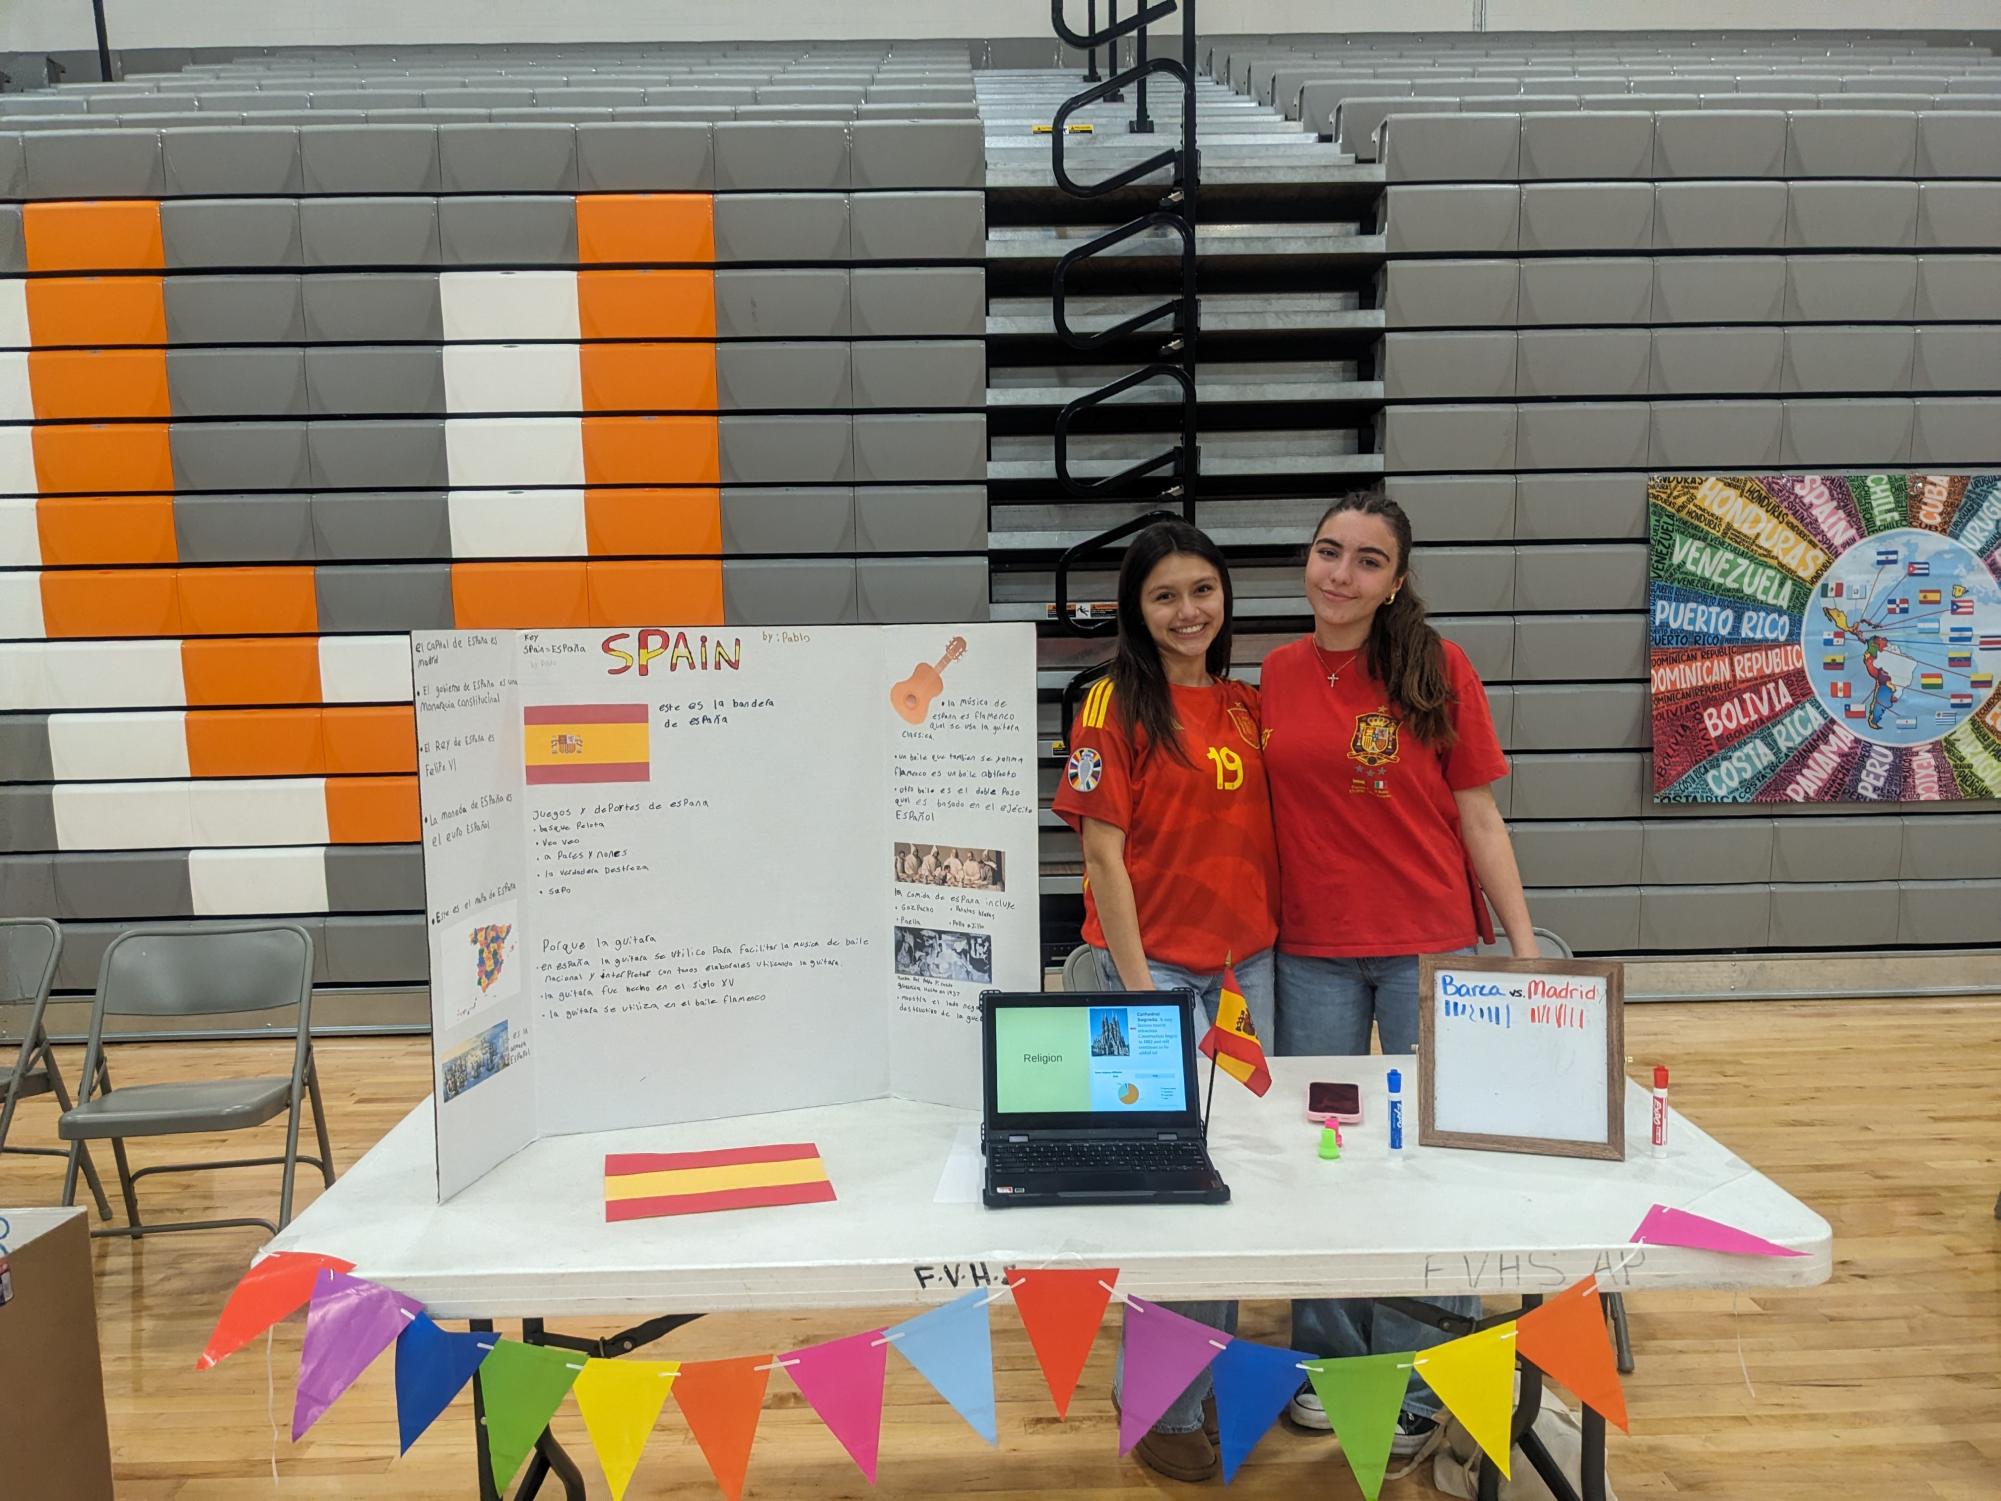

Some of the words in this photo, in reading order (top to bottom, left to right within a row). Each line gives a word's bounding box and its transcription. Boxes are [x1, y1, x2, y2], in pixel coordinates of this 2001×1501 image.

[1685, 508, 1723, 533] HONDURAS
[1793, 475, 1858, 549] SPAIN
[1866, 475, 1900, 526] CHILE
[1919, 475, 1950, 525] CUBA
[1698, 476, 1825, 578] HONDURAS
[1672, 534, 1792, 610] VENEZUELA
[1655, 600, 1734, 635] PUERTO
[1741, 610, 1790, 642] RICO
[1694, 635, 1720, 646] RICO
[1650, 659, 1731, 693] DOMINICAN
[1734, 645, 1804, 680] REPUBLIC
[664, 718, 678, 729] de
[1703, 678, 1793, 738] BOLIVIA
[1208, 746, 1244, 790] 19
[1706, 739, 1775, 796] COSTA
[1772, 702, 1826, 750] RICA
[1786, 725, 1855, 802] PANAMA
[1857, 745, 1895, 800] PERU
[1527, 979, 1596, 1000] Madrid
[1023, 1053, 1063, 1064] Religion
